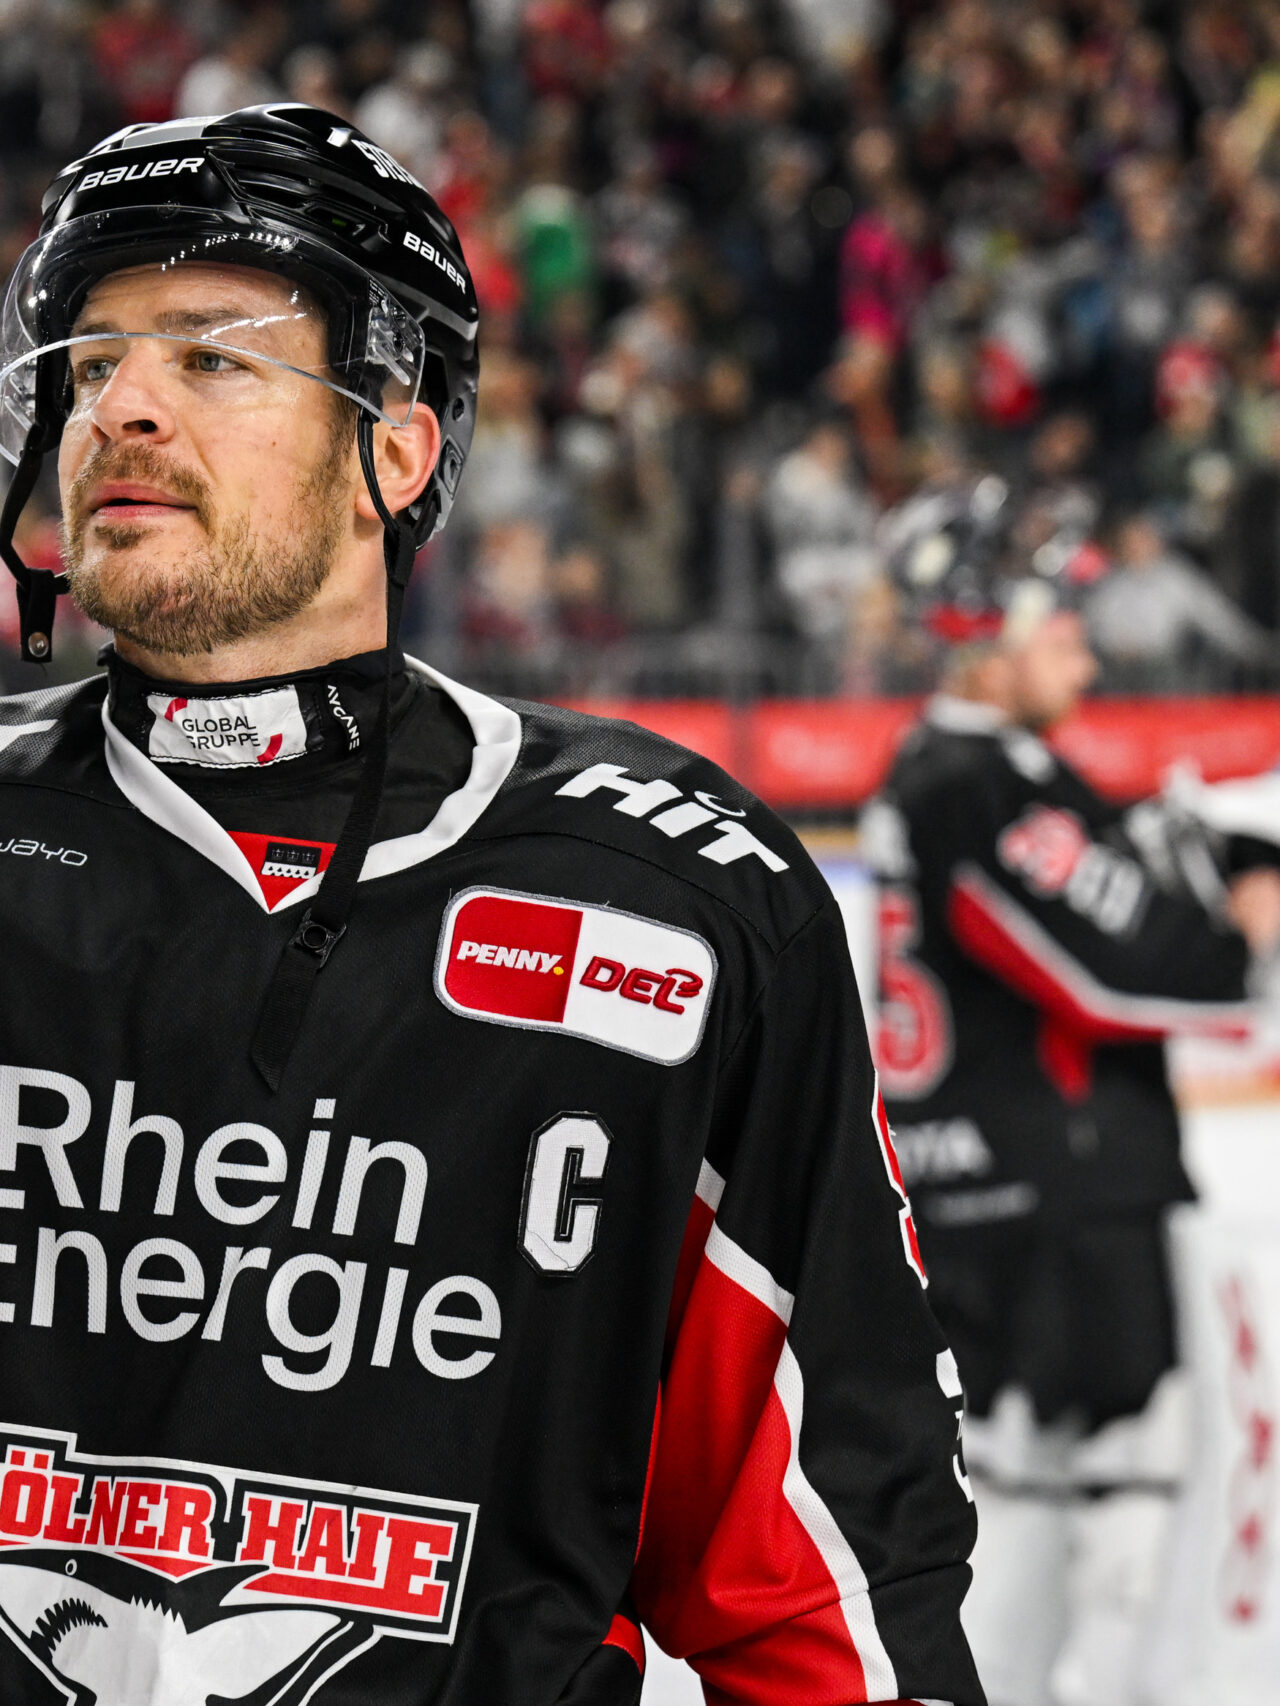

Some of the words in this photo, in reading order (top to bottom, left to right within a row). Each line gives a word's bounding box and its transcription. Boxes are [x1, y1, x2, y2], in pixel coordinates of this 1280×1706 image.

[77, 156, 205, 193] BAUER
[403, 231, 466, 295] BAUER
[182, 715, 257, 733] GLOBAL
[521, 1113, 612, 1274] C
[239, 1494, 455, 1619] HAIE
